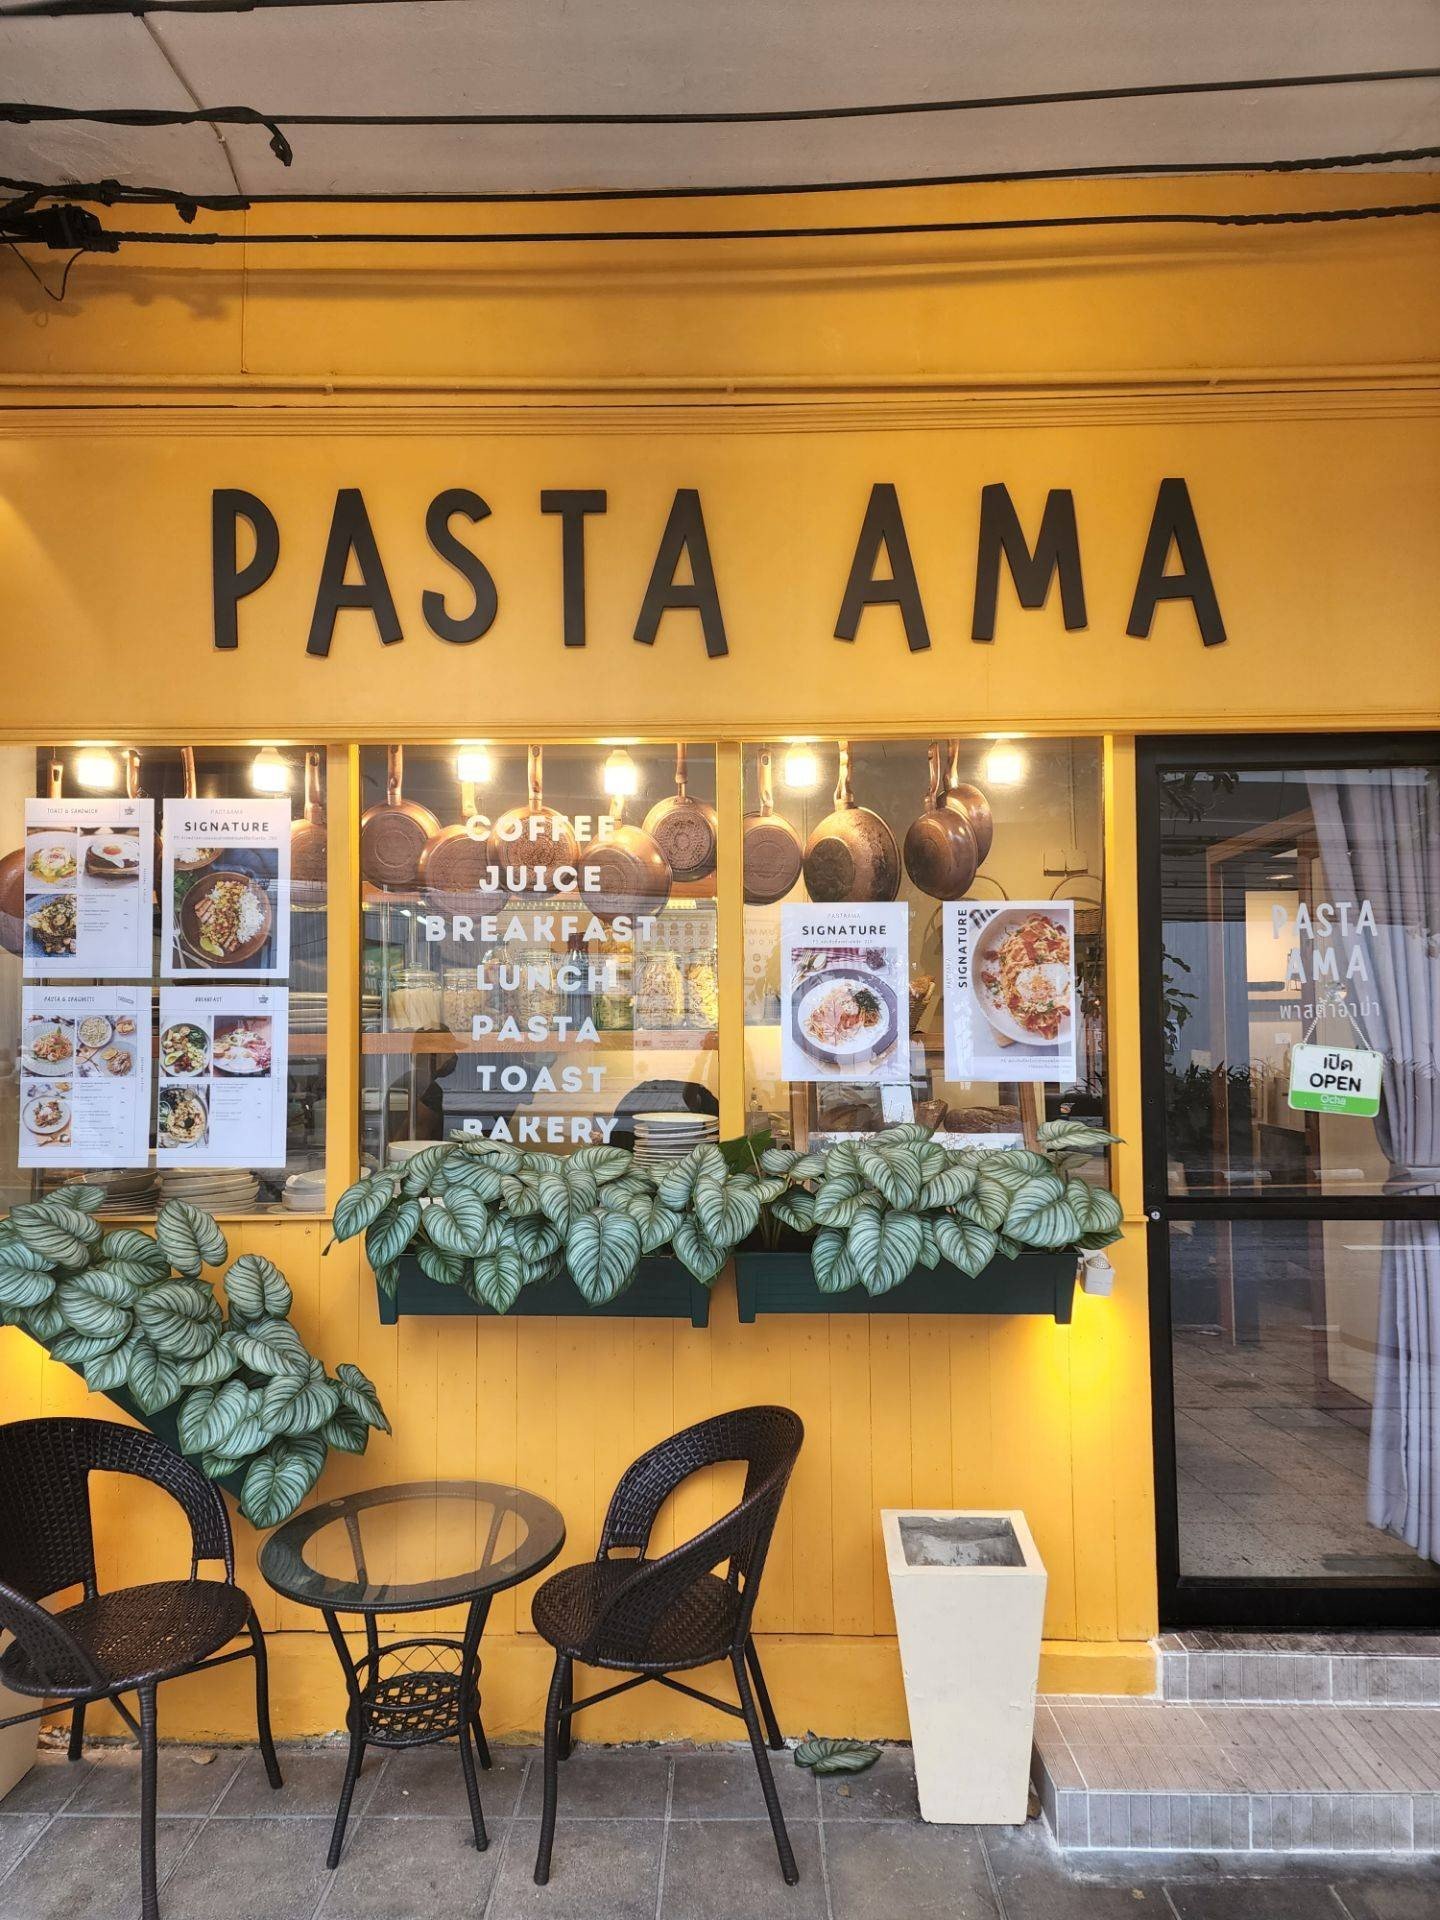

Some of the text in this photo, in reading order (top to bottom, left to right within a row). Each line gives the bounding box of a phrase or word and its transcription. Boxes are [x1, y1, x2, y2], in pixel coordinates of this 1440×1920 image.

[212, 477, 1228, 658] PASTA AMA
[184, 821, 270, 832] SIGNATURE
[466, 814, 616, 842] COFFEE
[479, 865, 602, 894] JUICE
[425, 915, 658, 942] BREAKFAST
[802, 925, 887, 936] SIGNATURE
[1271, 899, 1378, 940] PASTA
[957, 909, 968, 989] SIGNATURE
[476, 965, 611, 992] LUNCH
[1285, 945, 1369, 984] AMA
[472, 1015, 601, 1043] PASTA
[1323, 1053, 1353, 1072] เปิด
[477, 1065, 607, 1093] TOAST
[1309, 1073, 1362, 1092] OPEN
[463, 1116, 620, 1144] BAKERY
